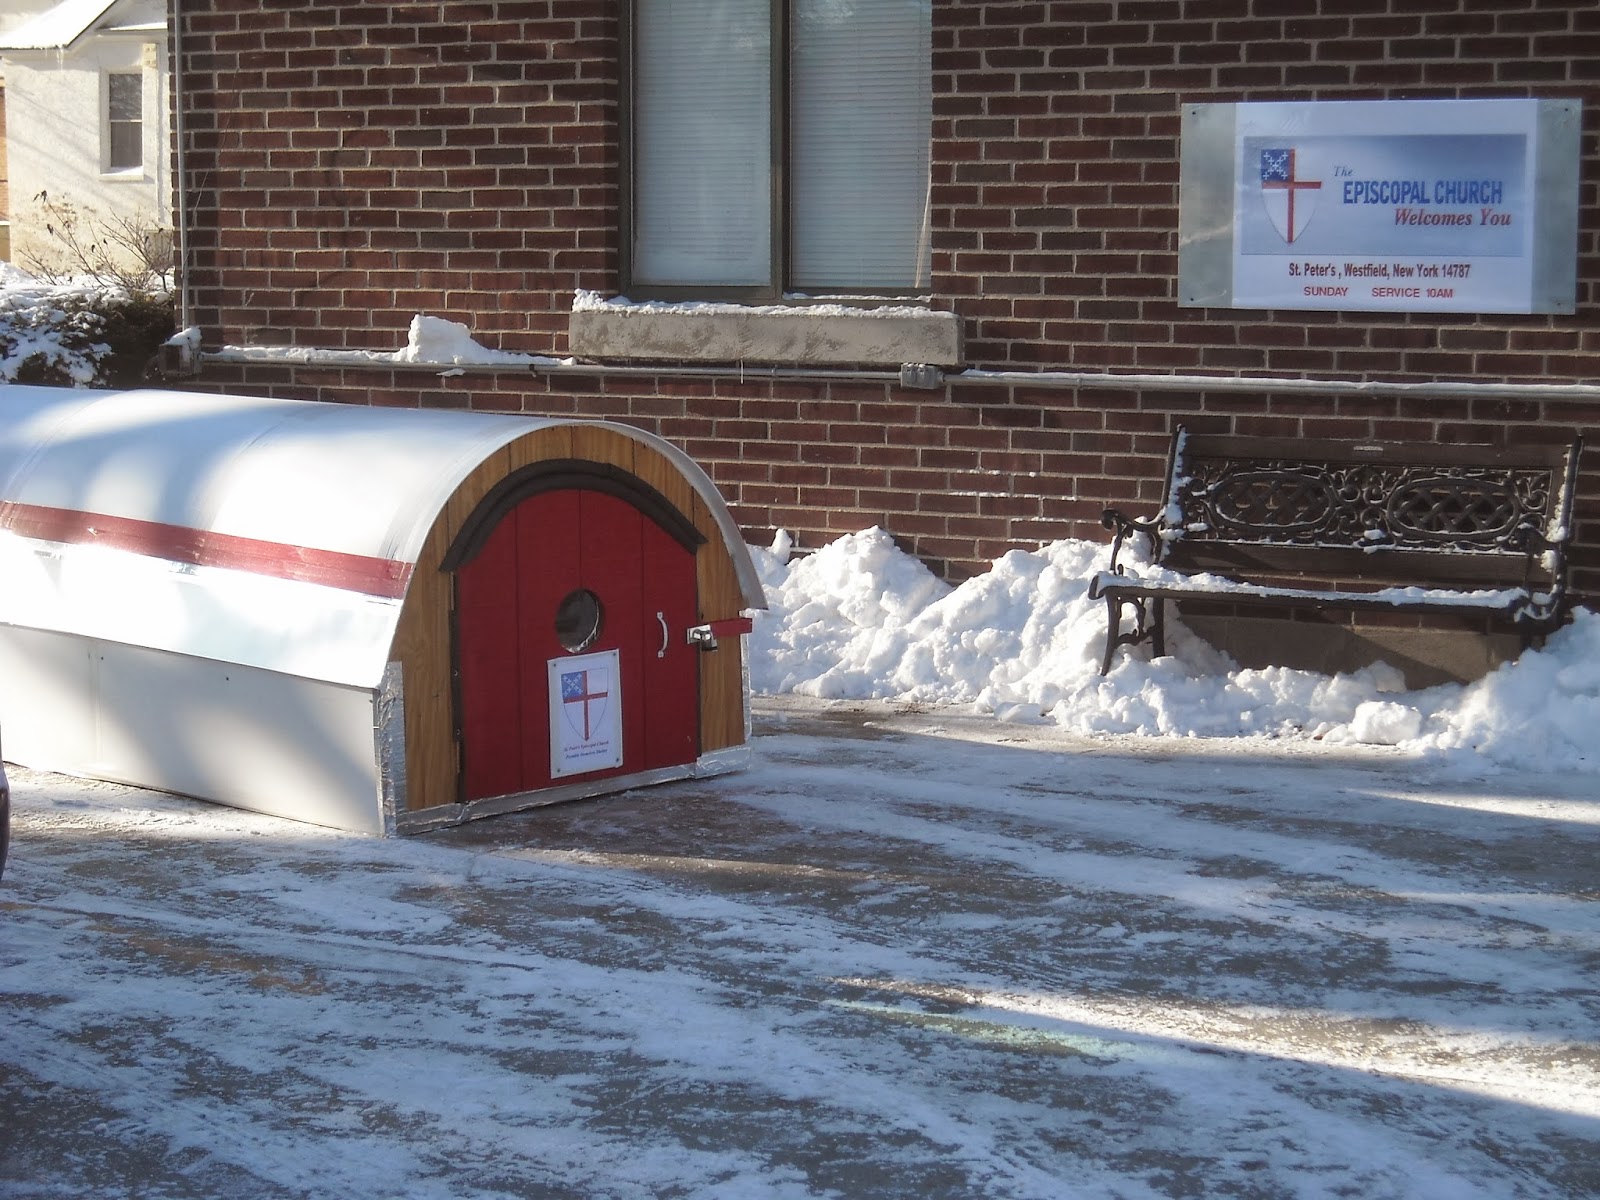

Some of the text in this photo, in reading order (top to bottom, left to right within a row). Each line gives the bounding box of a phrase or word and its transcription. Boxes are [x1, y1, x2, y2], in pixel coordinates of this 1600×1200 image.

[1333, 165, 1354, 177] The
[1342, 180, 1503, 205] EPISCOPAL CHURCH
[1394, 207, 1512, 226] Welcomes You
[1288, 262, 1302, 277] St.
[1343, 263, 1390, 280] Westfield,
[1392, 263, 1414, 278] New
[1416, 263, 1439, 278] York
[1441, 264, 1471, 278] 14787
[1303, 286, 1454, 298] SUNDAY SERVICE 10AM
